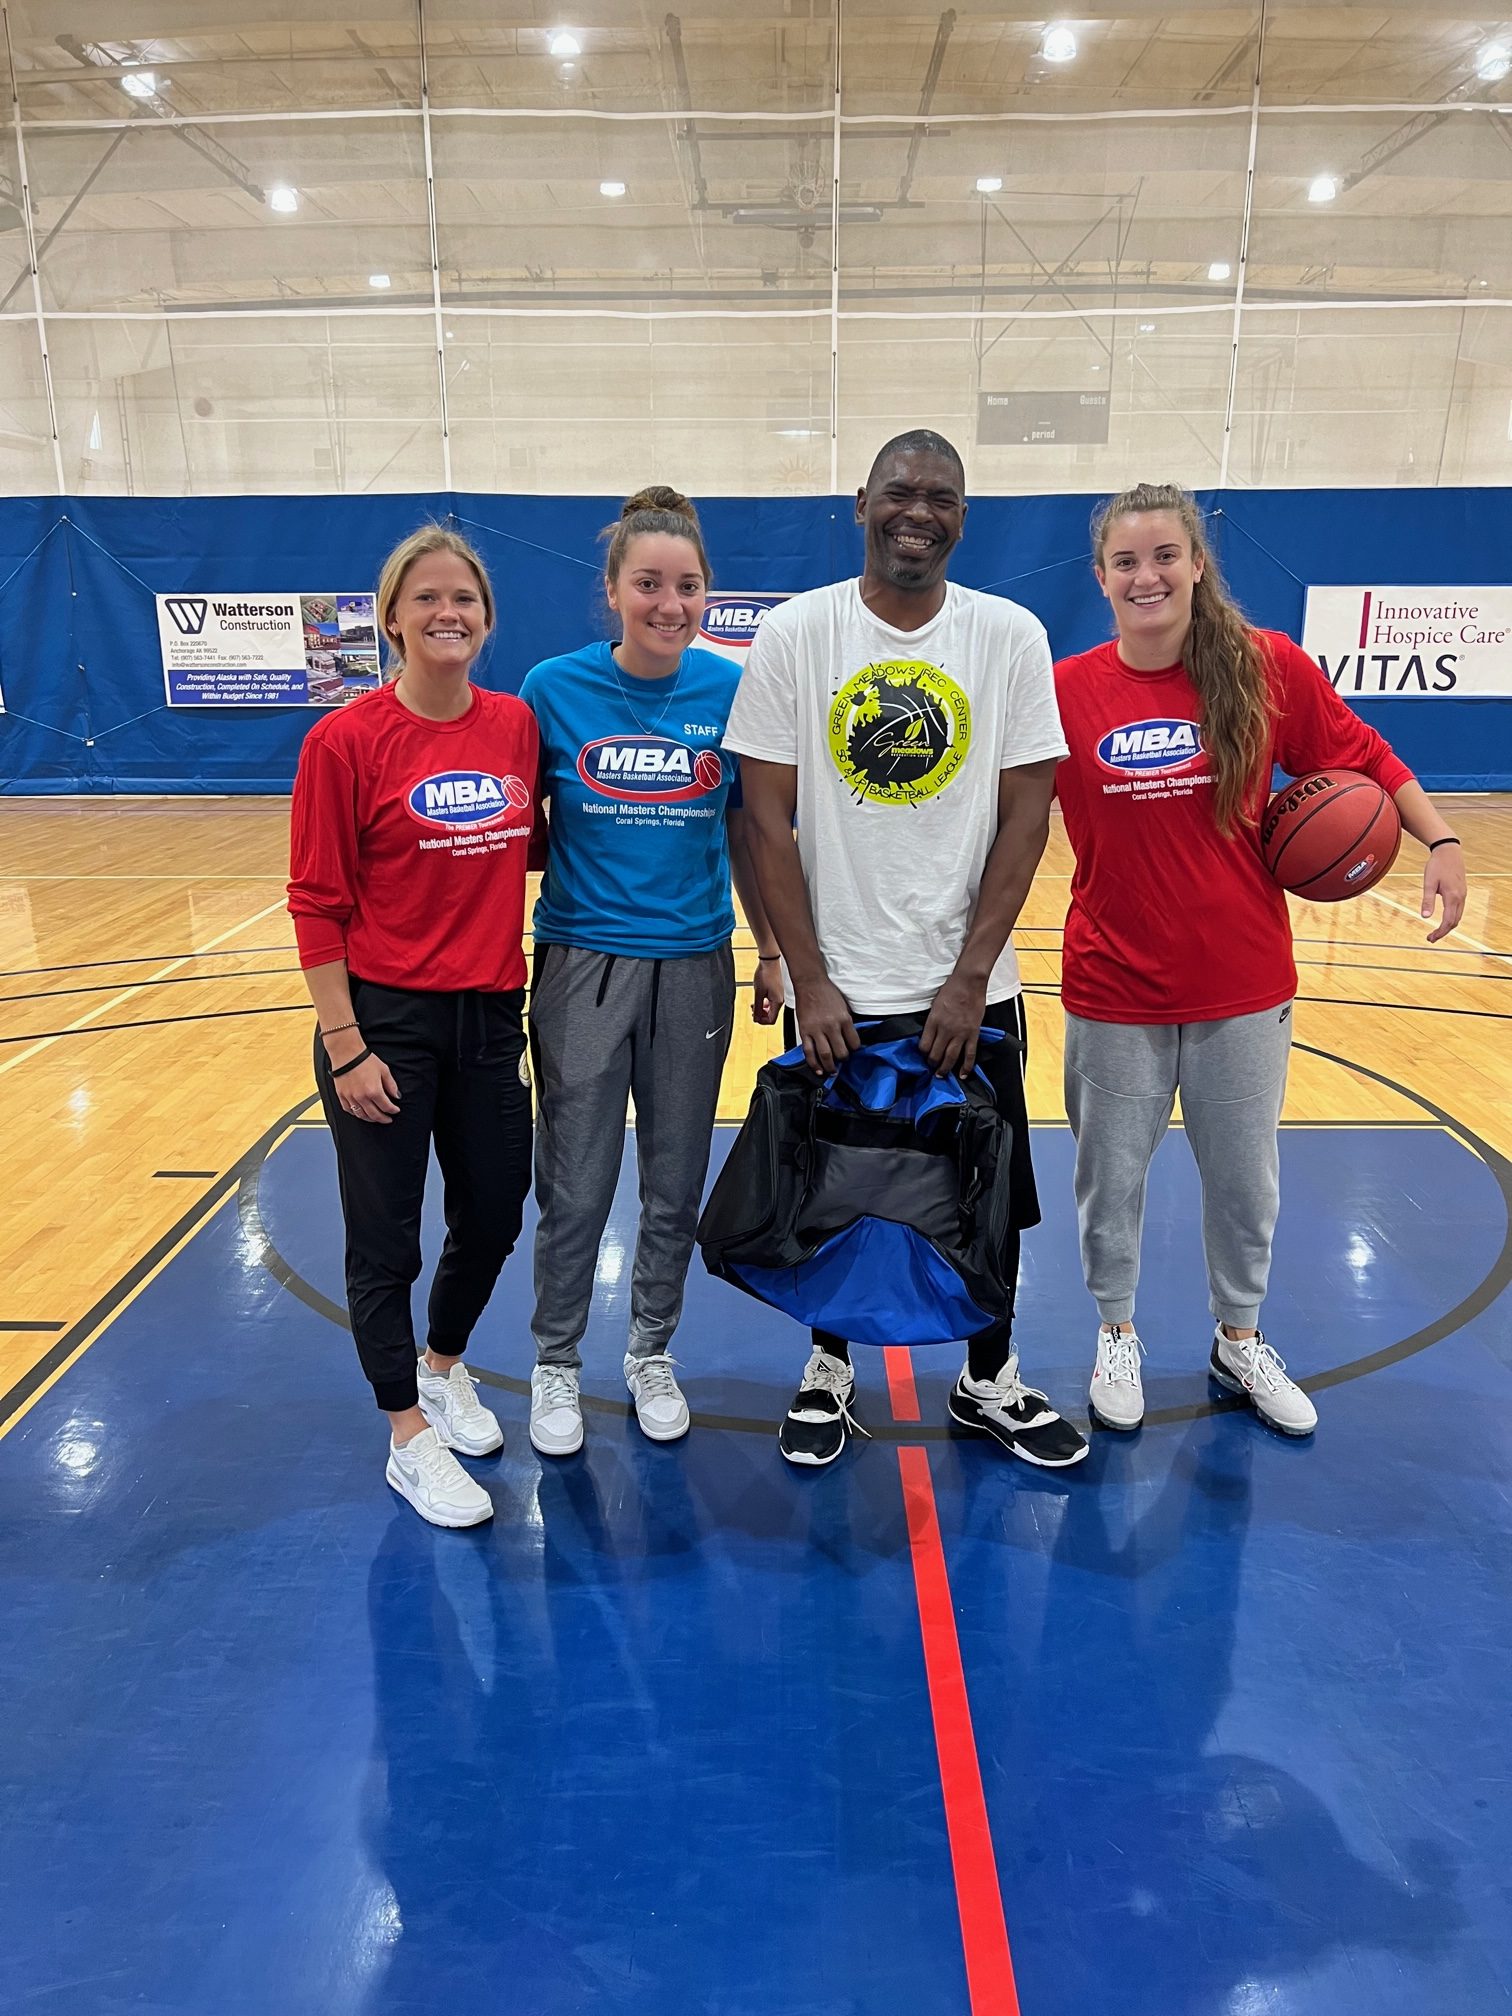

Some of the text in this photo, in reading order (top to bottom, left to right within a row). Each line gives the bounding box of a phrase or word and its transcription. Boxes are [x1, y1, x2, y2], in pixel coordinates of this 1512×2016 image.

[987, 396, 1008, 406] Home
[1080, 394, 1106, 406] Guests
[1032, 429, 1056, 440] period
[212, 602, 294, 617] Watterson
[1376, 601, 1479, 620] Innovative
[220, 619, 291, 631] Construction
[1373, 625, 1453, 650] Hospice
[187, 674, 215, 682] Providing
[269, 674, 291, 682] Quality
[176, 683, 216, 691] Construction,
[217, 683, 250, 691] Completed
[261, 683, 290, 691] Schedule,
[222, 693, 244, 701] Budget
[832, 666, 968, 741] GREEN MEADOWS REC CENTER
[684, 724, 718, 737] STAFF
[874, 732, 930, 758] Green
[1110, 724, 1196, 756] MBA
[891, 746, 934, 755] meadows
[1110, 746, 1196, 763] Masters Basketball Association
[597, 746, 692, 774] MBA
[596, 771, 692, 783] Masters Basketball Association
[869, 785, 932, 800] BASKETBALL
[934, 751, 962, 788] LEAGUE
[424, 778, 502, 808] MBA
[1102, 782, 1132, 794] National
[1133, 779, 1166, 792] Masters
[1148, 791, 1172, 799] Springs,
[1173, 788, 1193, 796] Florida
[426, 800, 505, 817] Masters Basketball Association
[582, 802, 617, 815] National
[620, 804, 656, 816] Masters
[616, 817, 685, 827] Coral Springs, Florida
[418, 836, 452, 850] National
[454, 833, 484, 846] Masters
[452, 842, 507, 857] Coral Springs, Florida
[1348, 860, 1368, 878] MBA
